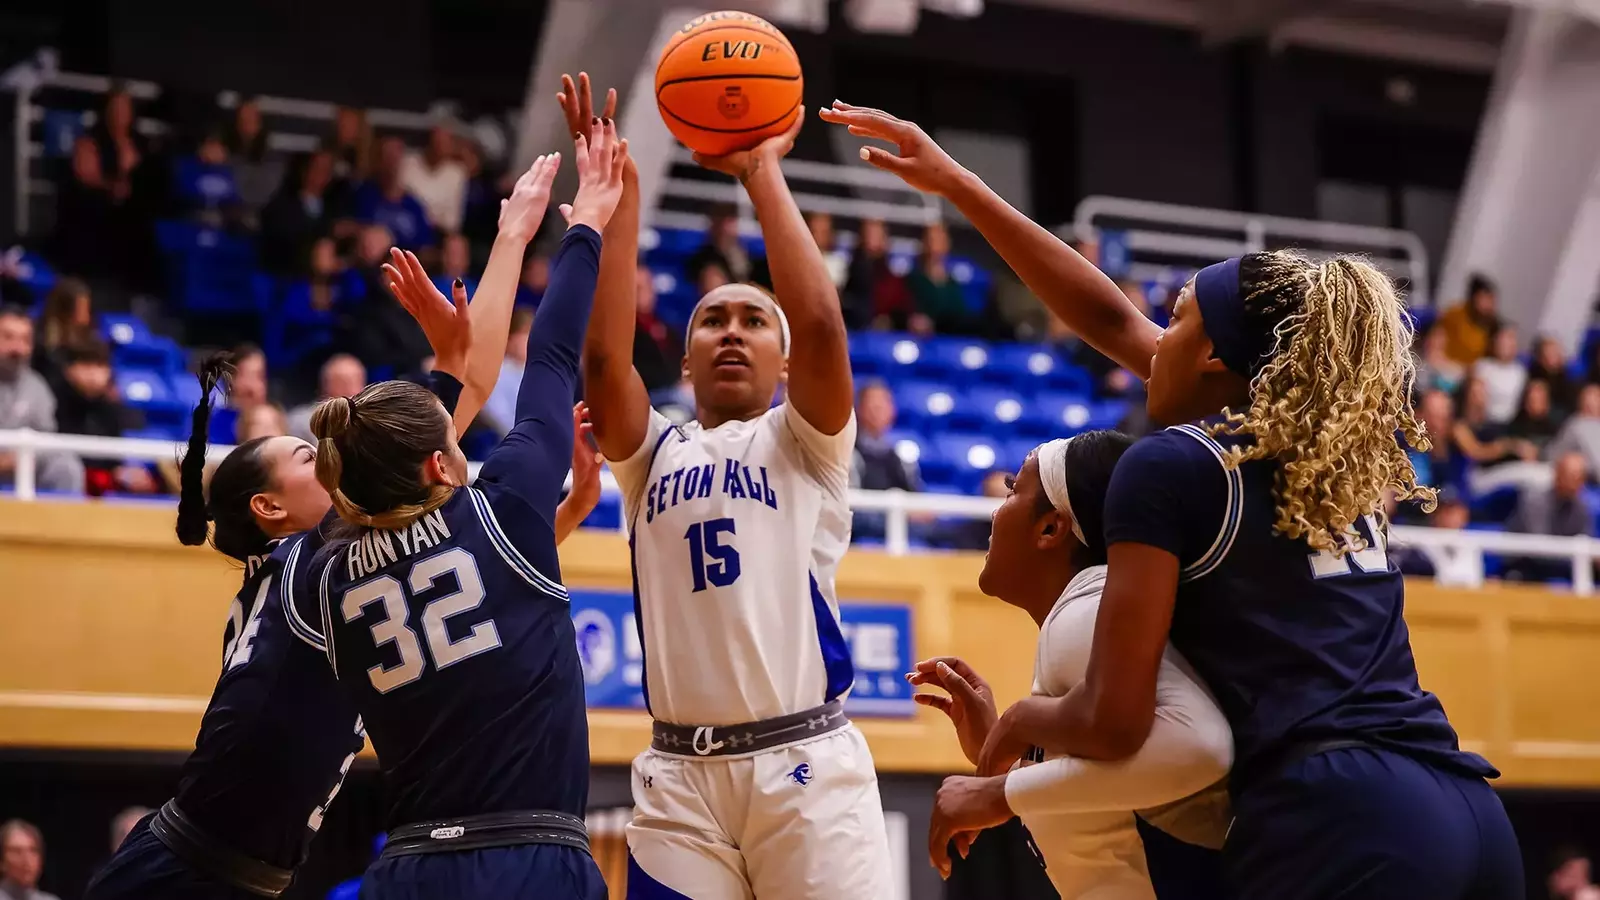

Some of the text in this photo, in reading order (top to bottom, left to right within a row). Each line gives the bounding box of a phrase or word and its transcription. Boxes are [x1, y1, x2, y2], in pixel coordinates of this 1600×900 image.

[702, 40, 764, 62] EVO
[646, 458, 778, 525] SETON HALL
[347, 508, 452, 582] RUNYAN
[683, 517, 741, 593] 15
[340, 546, 503, 695] 32
